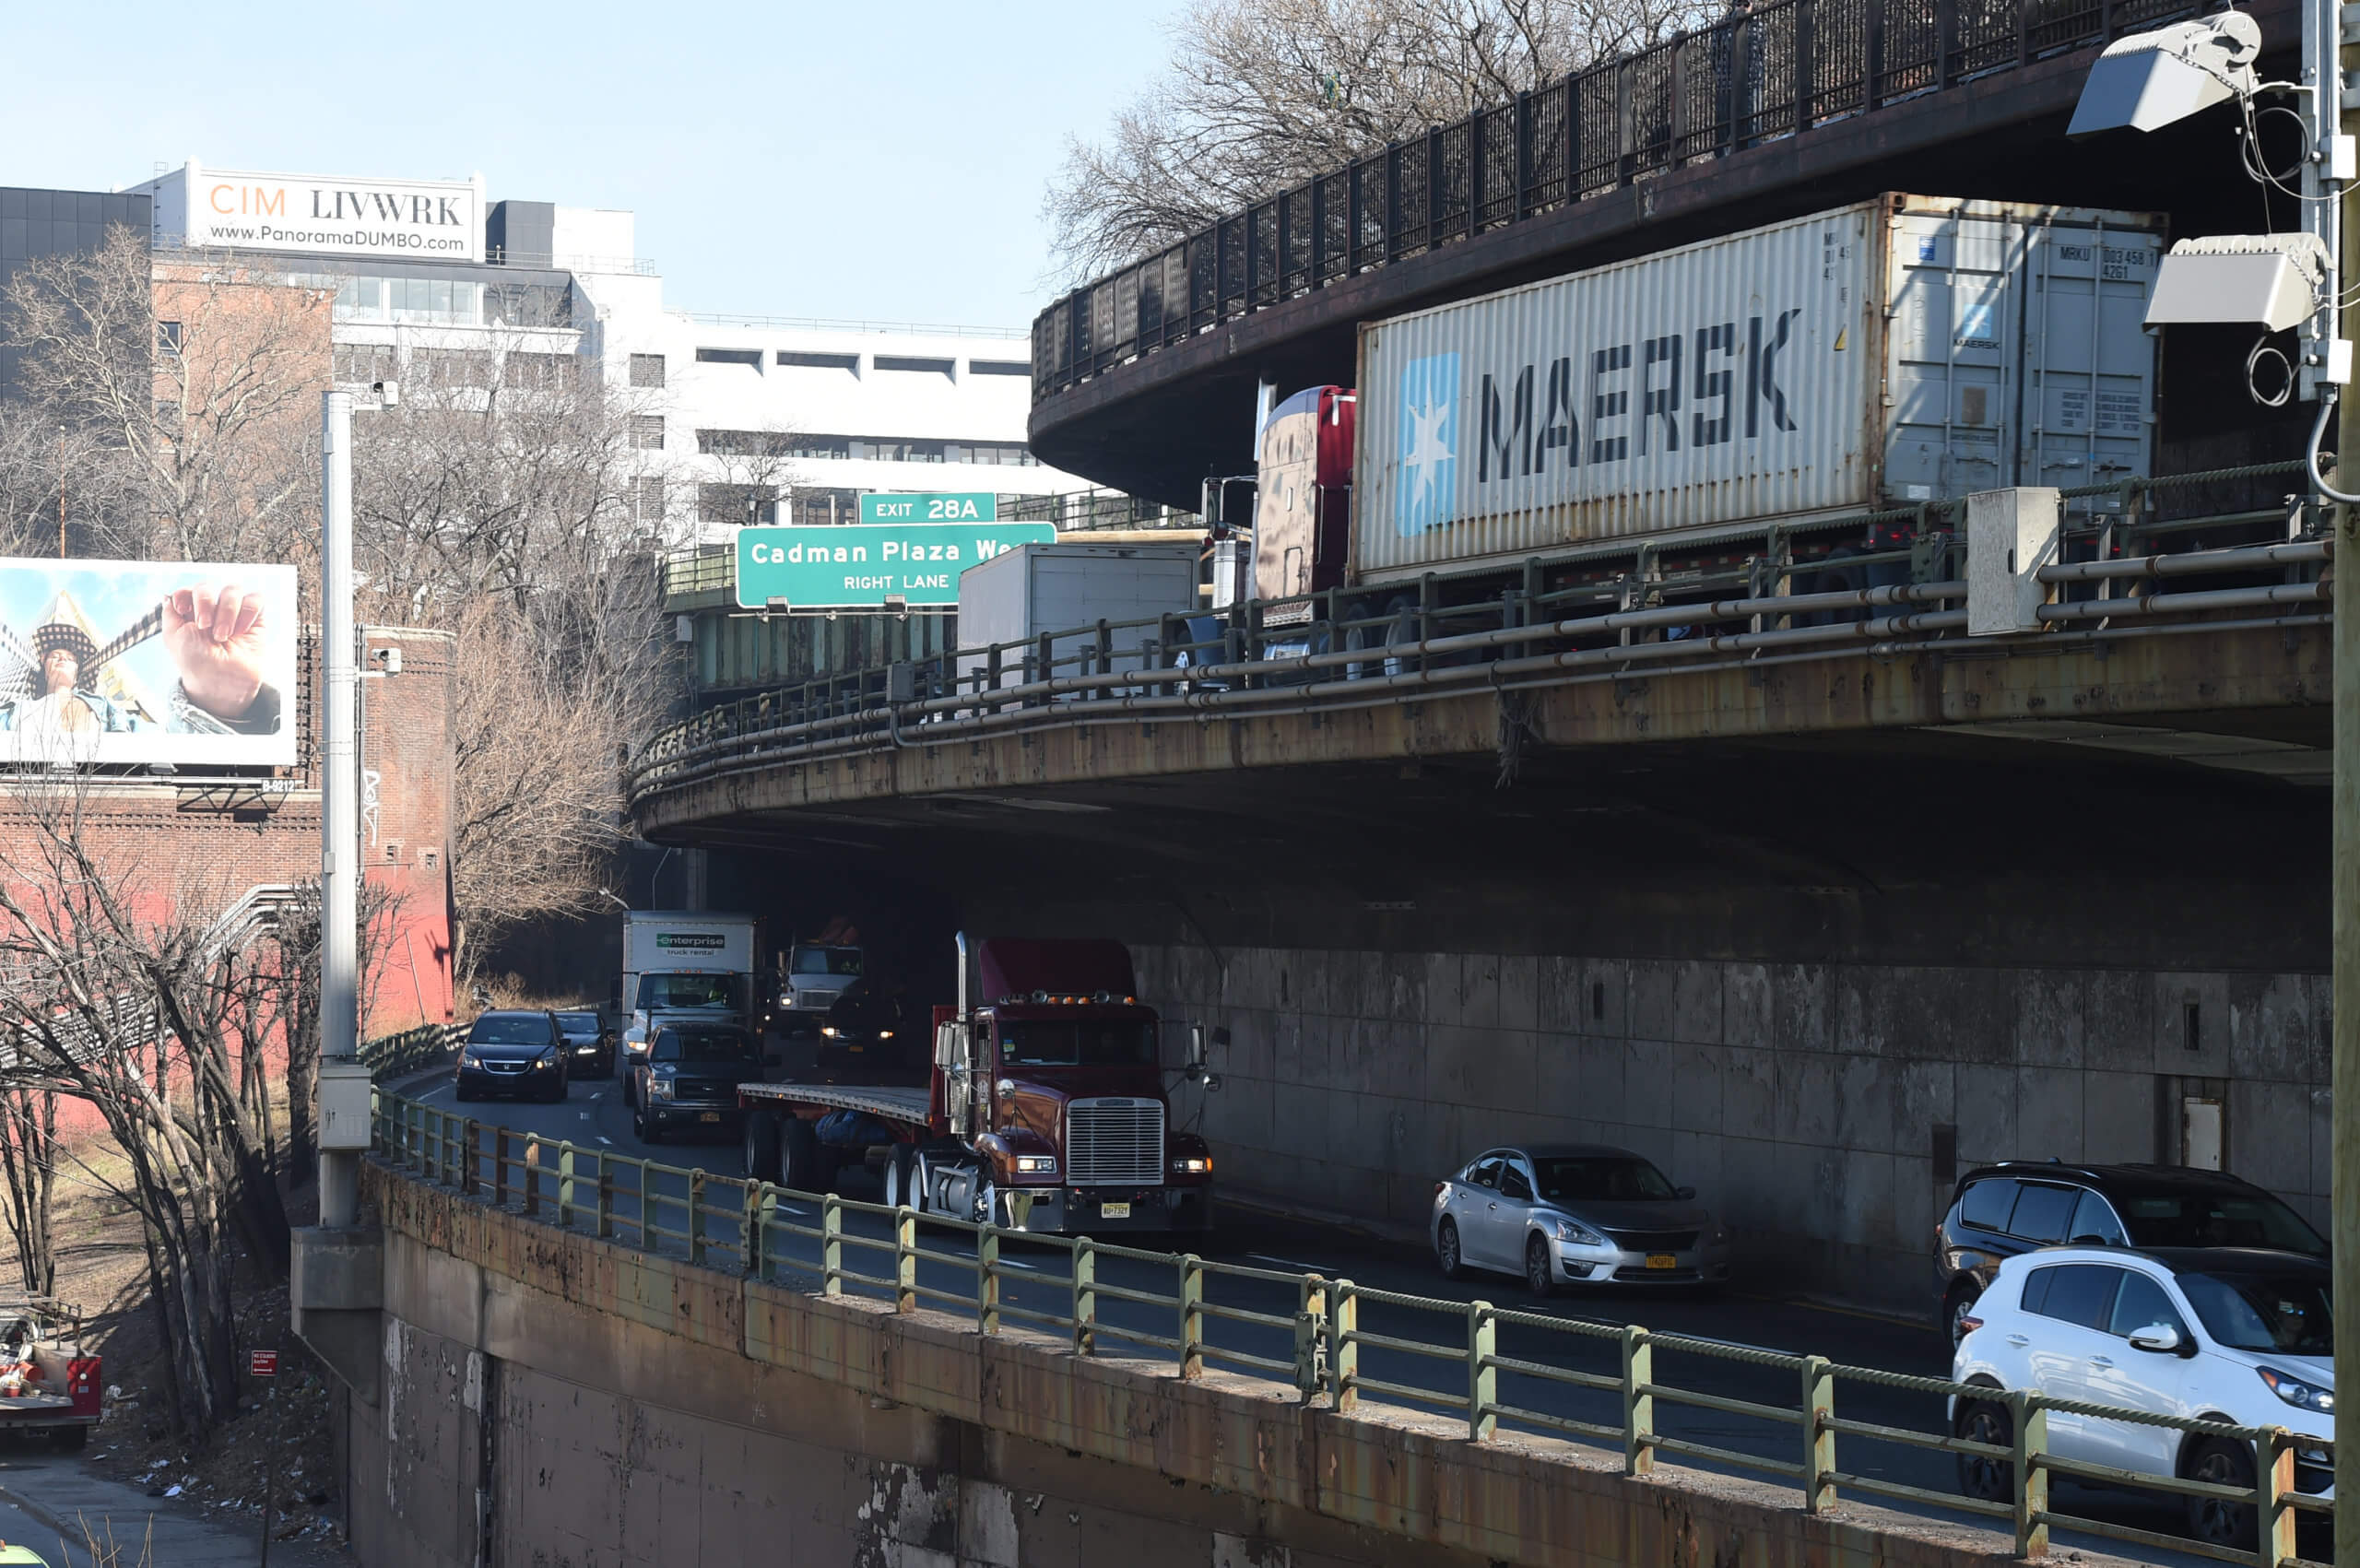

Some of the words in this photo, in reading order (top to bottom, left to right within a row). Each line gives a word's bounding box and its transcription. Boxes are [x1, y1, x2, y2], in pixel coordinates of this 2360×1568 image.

[209, 183, 286, 217] CIM
[310, 189, 464, 226] LIVWRK
[210, 225, 465, 252] www.PanoramaDUMBO.com
[2060, 246, 2091, 262] MRKU
[1479, 308, 1802, 484] MAERSK
[877, 502, 914, 517] EXIT
[927, 500, 979, 519] 28A
[751, 543, 867, 563] Cadman
[882, 541, 961, 561] Plaza
[976, 538, 1038, 560] We
[844, 575, 893, 590] RIGHT
[903, 574, 950, 589] LANE
[262, 779, 295, 793] B-9212
[657, 936, 724, 946] enterprise
